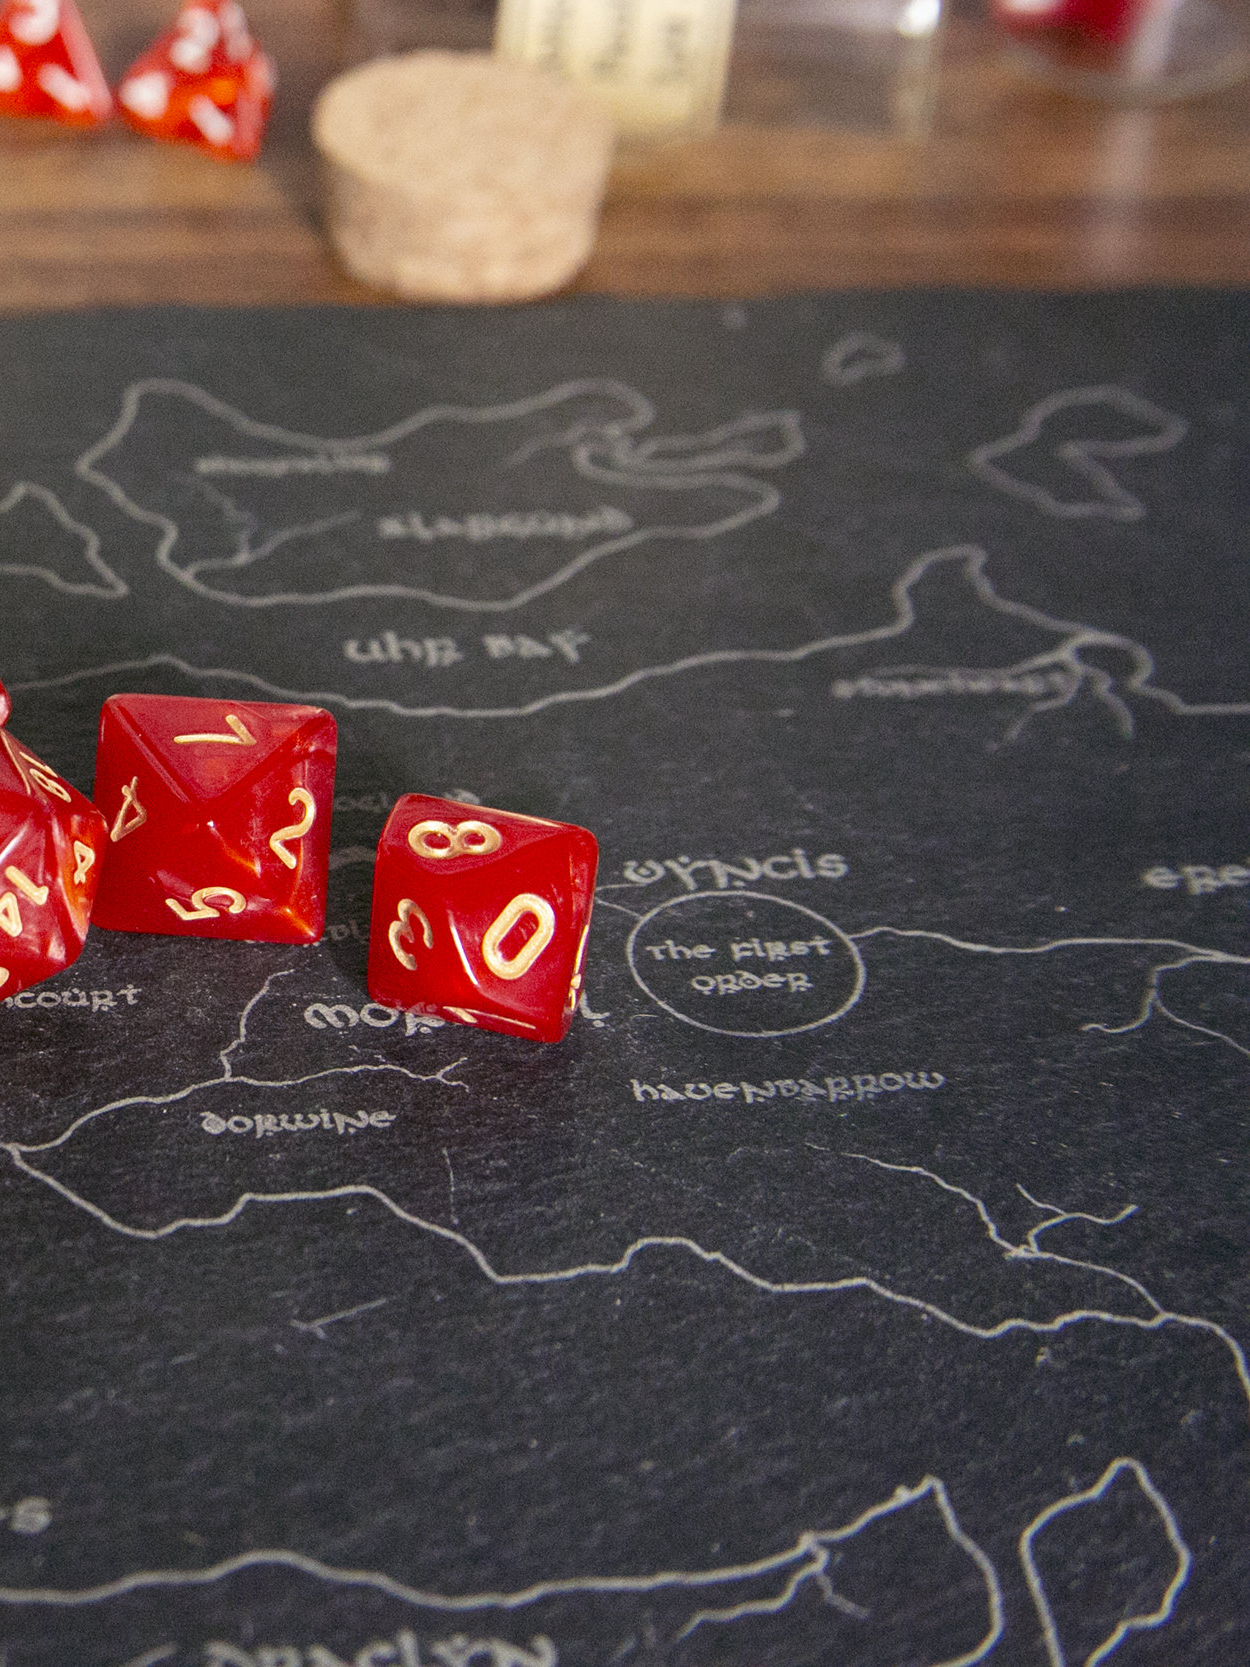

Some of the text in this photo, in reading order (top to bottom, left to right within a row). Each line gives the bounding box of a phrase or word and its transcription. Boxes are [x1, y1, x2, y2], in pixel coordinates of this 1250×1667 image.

[110, 775, 148, 843] 4
[269, 787, 316, 869] 2
[408, 820, 502, 860] 8
[164, 886, 247, 921] 5
[388, 898, 434, 971] 3
[482, 892, 556, 981] 0
